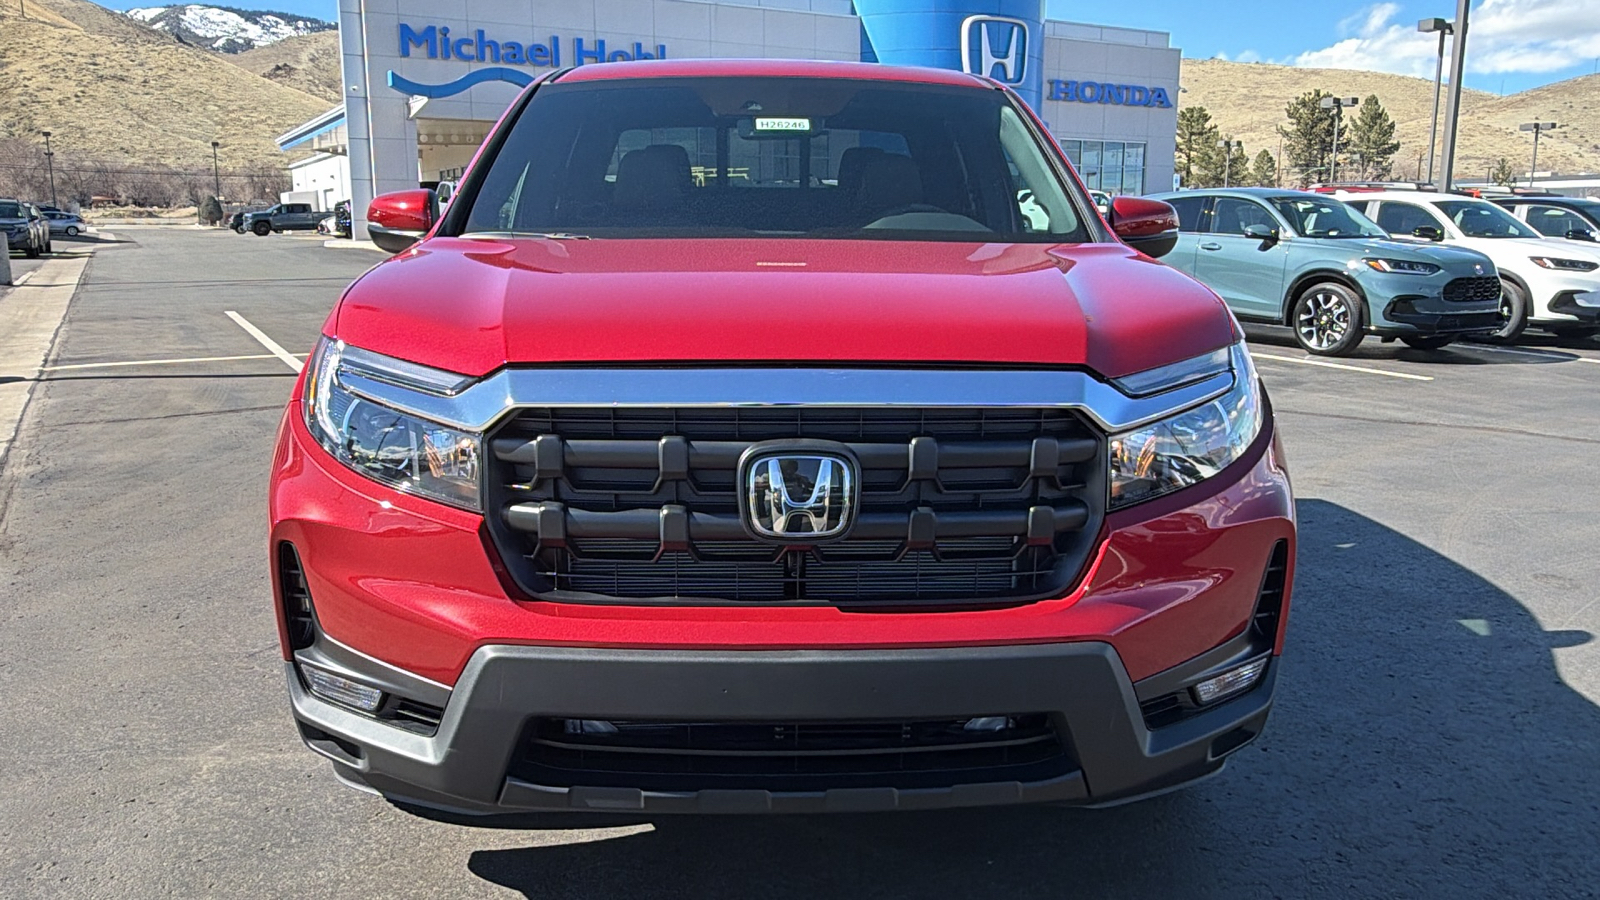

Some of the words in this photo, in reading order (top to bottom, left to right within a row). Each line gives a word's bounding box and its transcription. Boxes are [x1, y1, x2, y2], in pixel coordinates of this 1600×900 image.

[399, 23, 560, 67] Michael
[1048, 79, 1173, 108] HONDA
[760, 121, 806, 129] H26246
